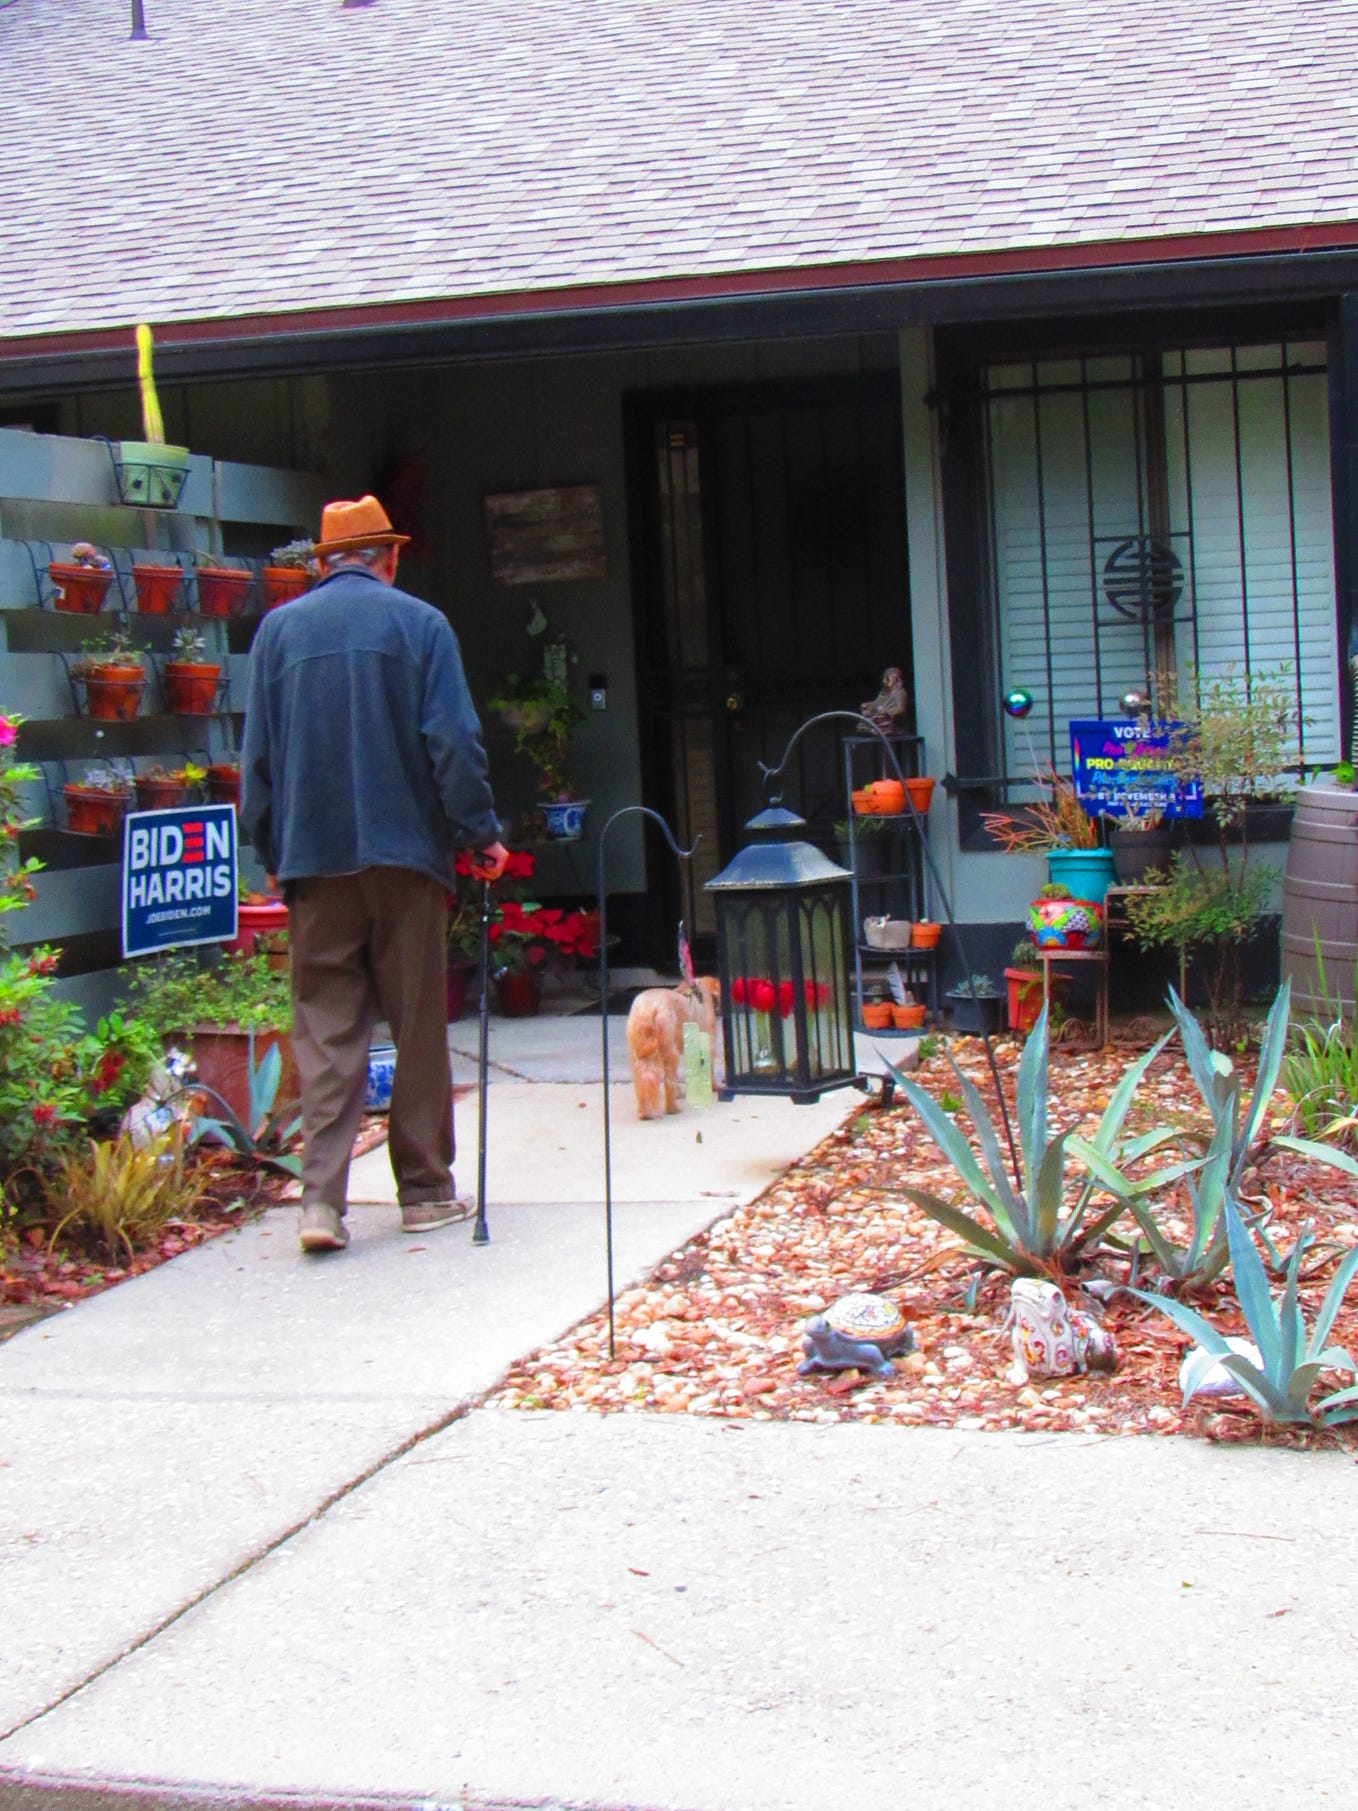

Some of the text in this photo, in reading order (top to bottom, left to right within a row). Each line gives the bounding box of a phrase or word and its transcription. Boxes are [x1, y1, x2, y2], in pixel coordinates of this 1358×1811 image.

[1114, 727, 1152, 739] VOTE
[130, 820, 230, 870] BIDEN
[130, 865, 231, 909] HARRIS
